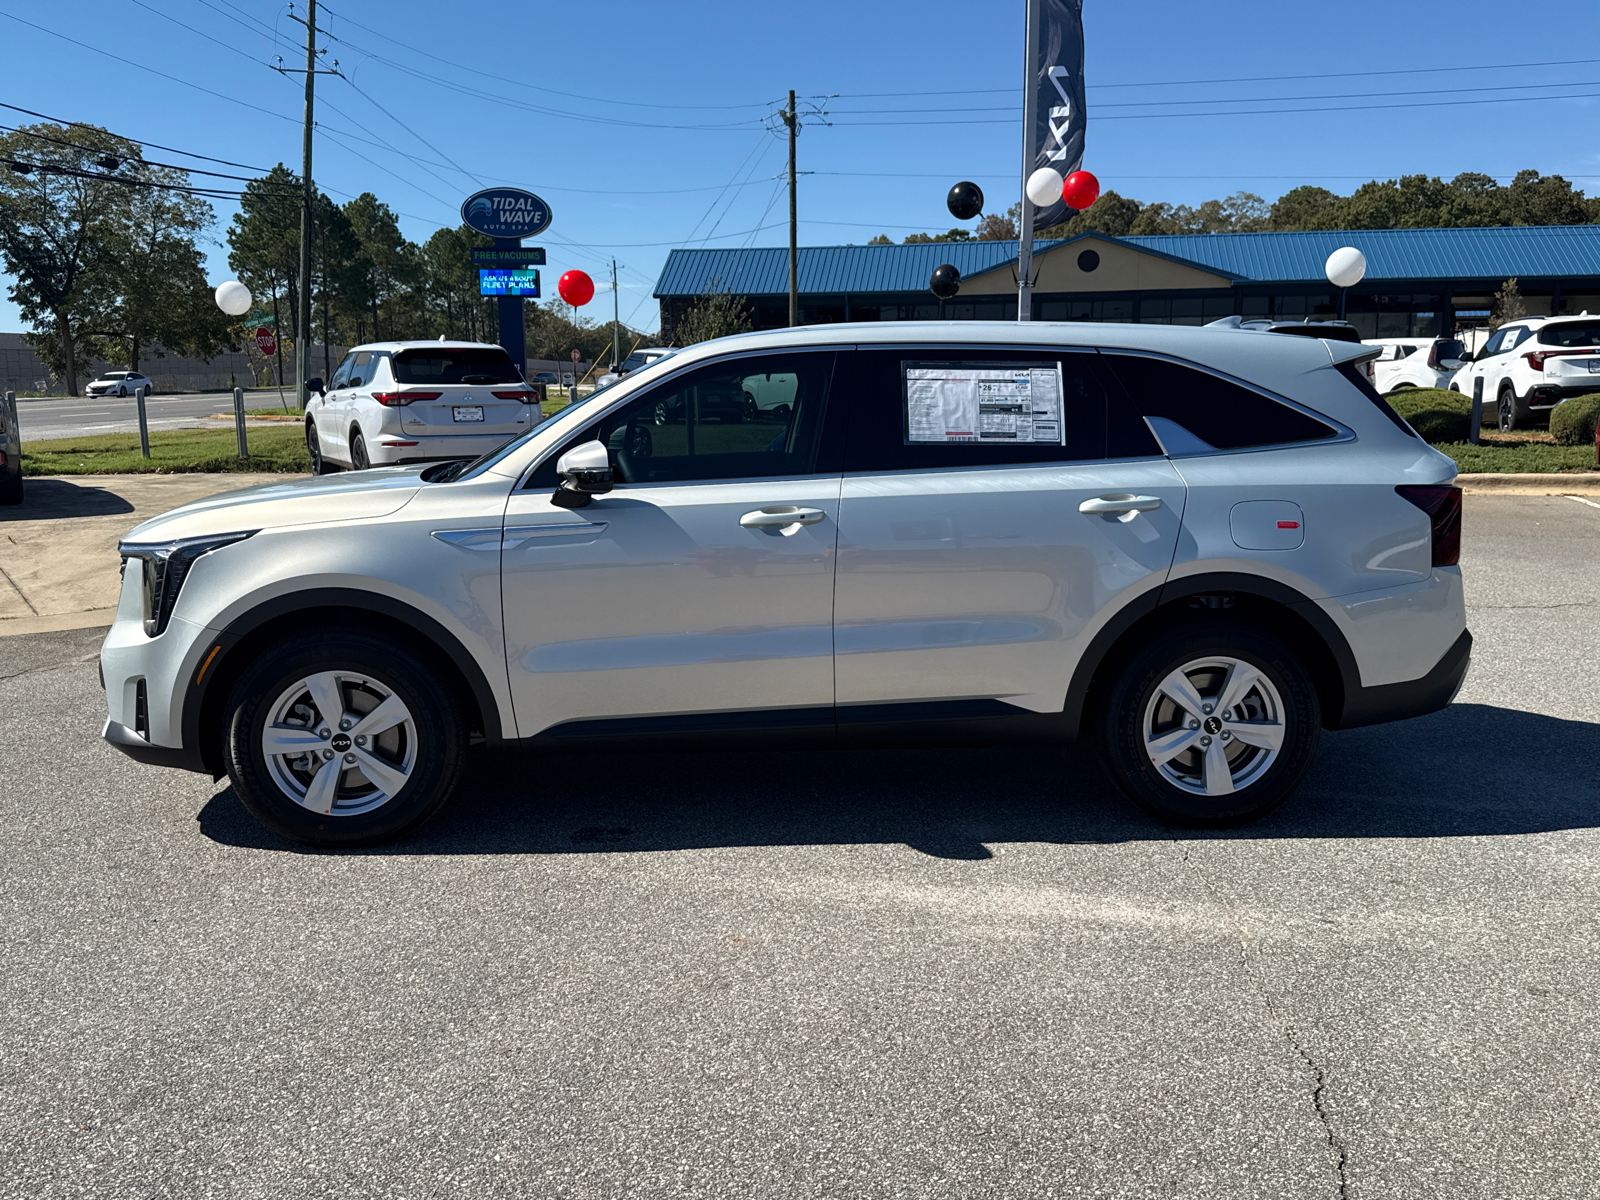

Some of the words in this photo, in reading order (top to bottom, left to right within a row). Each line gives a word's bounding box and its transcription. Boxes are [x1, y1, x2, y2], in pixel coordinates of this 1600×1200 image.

[1046, 65, 1070, 161] KIA
[493, 198, 533, 210] TIDAL
[500, 211, 542, 223] WAVE
[474, 251, 497, 259] FREE
[499, 251, 540, 260] VACUUMS
[508, 281, 535, 289] PLANS
[257, 336, 274, 347] STOP
